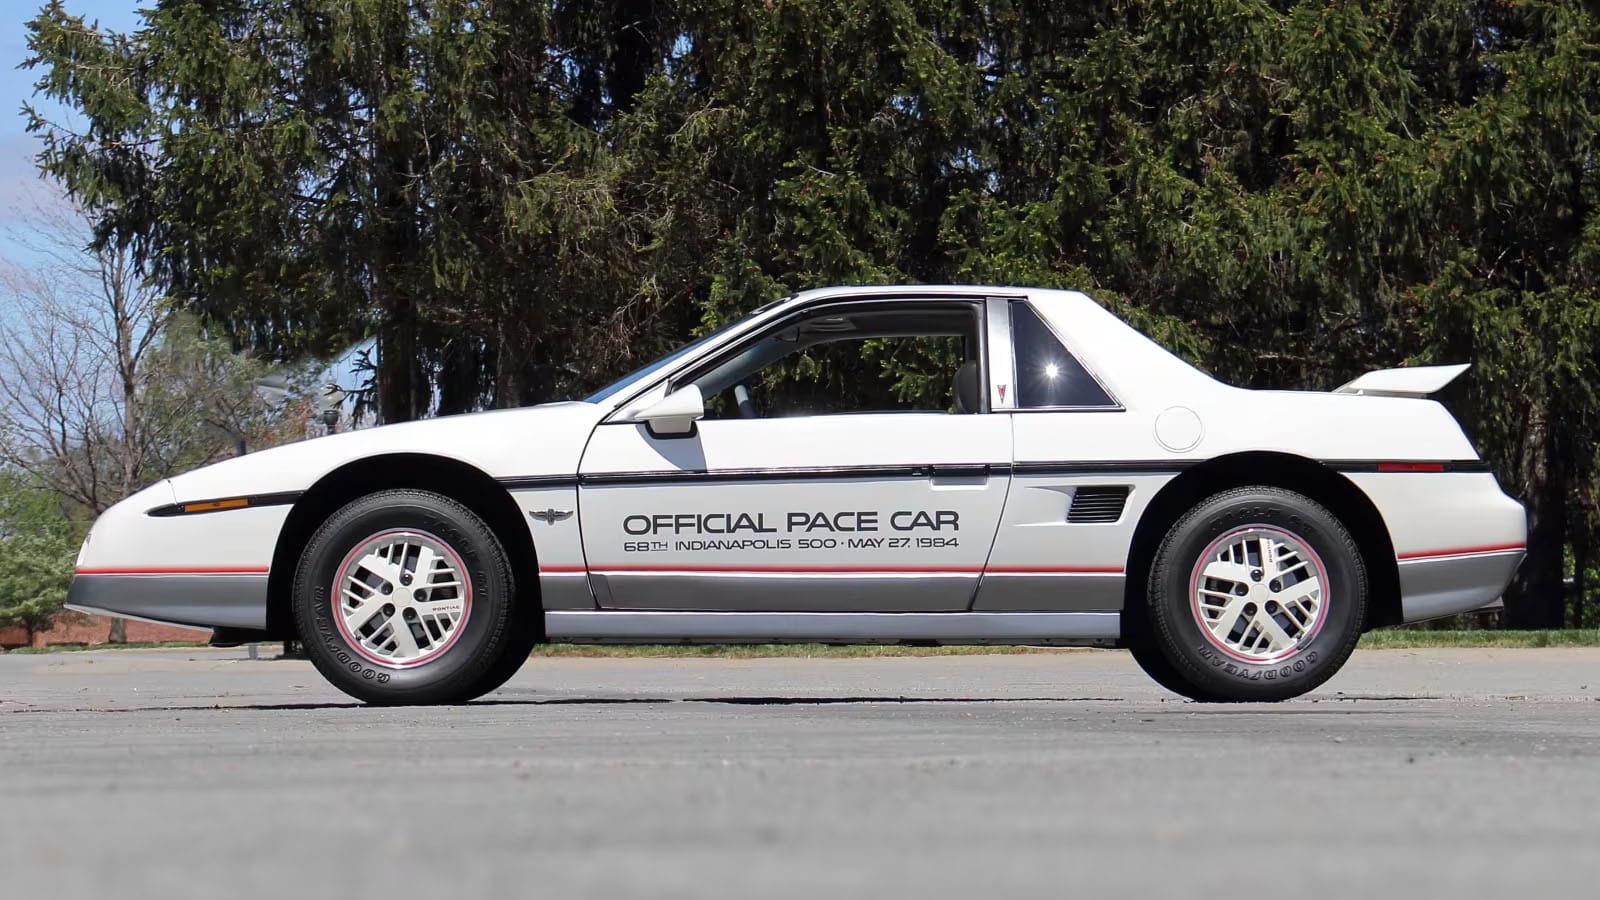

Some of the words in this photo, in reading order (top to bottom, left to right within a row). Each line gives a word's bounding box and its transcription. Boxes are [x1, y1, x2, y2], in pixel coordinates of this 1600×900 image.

[623, 512, 777, 535] OFFICIAL
[786, 511, 879, 533] PACE
[890, 510, 960, 531] CAR
[624, 541, 668, 552] 68TH
[675, 539, 792, 551] INDIANAPOLIS
[798, 539, 837, 549] 500
[847, 538, 885, 549] MAY
[915, 537, 960, 548] 1984
[1197, 644, 1319, 681] GOODYEAR
